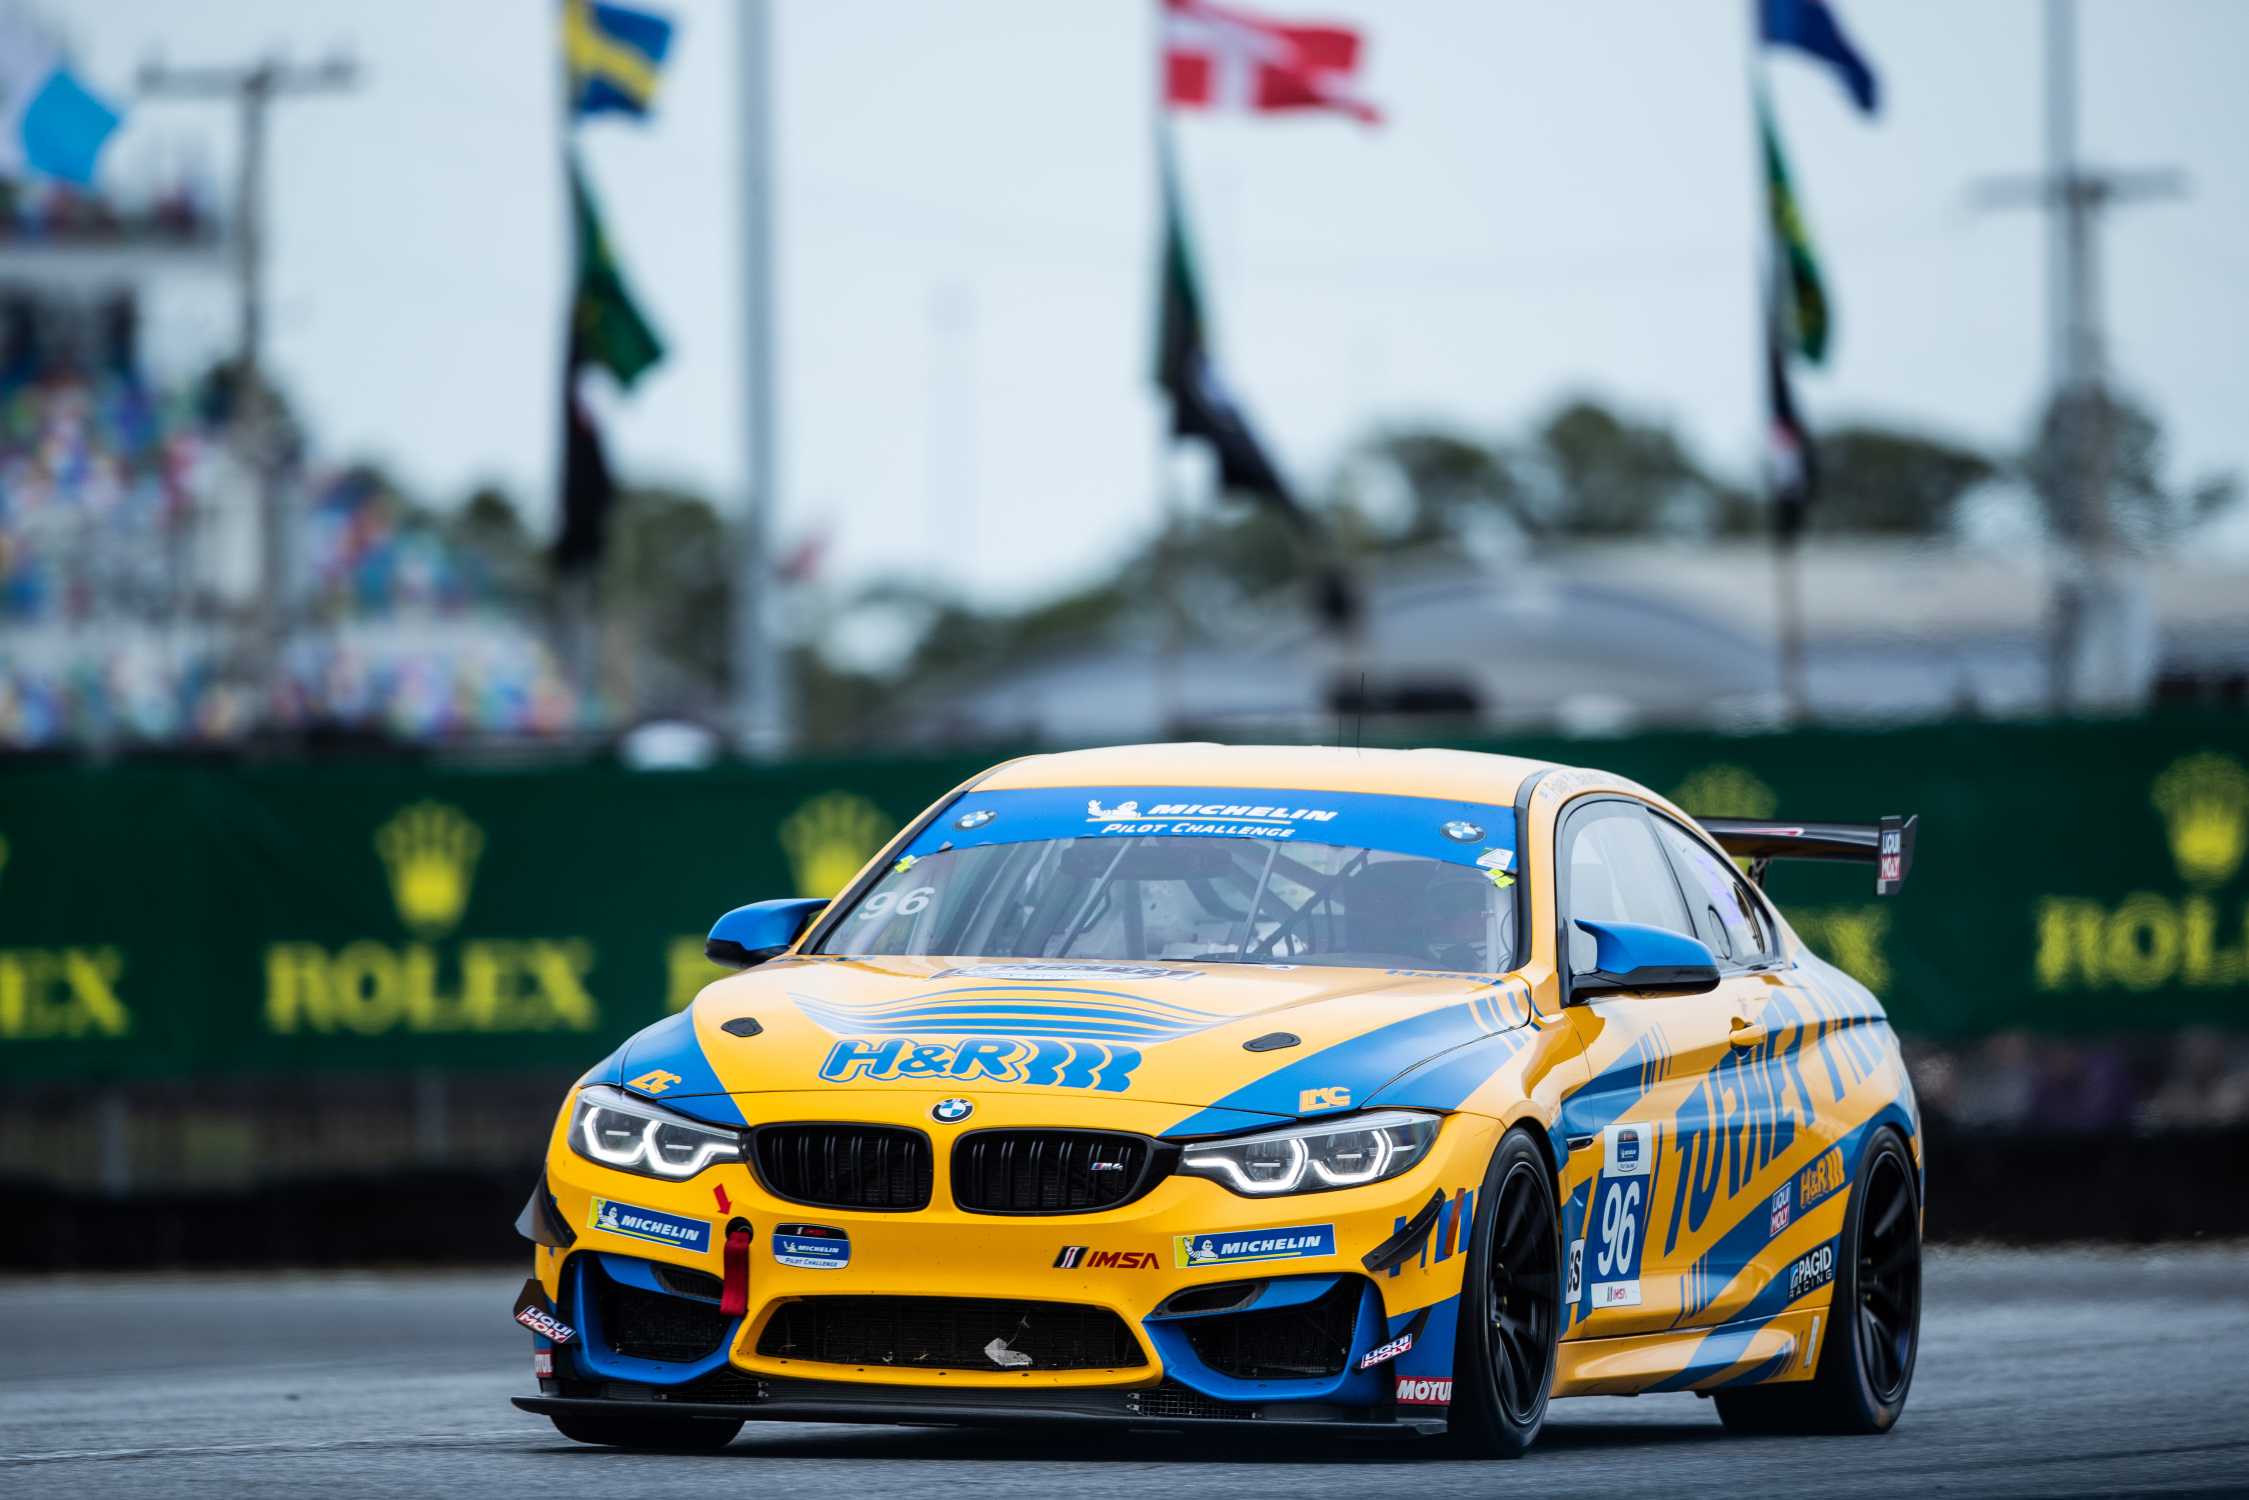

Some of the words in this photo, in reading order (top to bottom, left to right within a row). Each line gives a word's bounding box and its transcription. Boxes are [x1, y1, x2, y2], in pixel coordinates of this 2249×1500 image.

[1147, 804, 1339, 822] MICHELIN
[1101, 823, 1168, 834] PILOT
[1170, 822, 1296, 838] CHALLENGE
[859, 886, 936, 920] 96
[264, 938, 598, 1034] ROLEX
[818, 1038, 1040, 1083] H&R
[621, 1215, 699, 1241] MICHELIN
[1598, 1181, 1640, 1276] 96
[1770, 1204, 1791, 1234] MOLY
[797, 1245, 840, 1254] MICHELIN
[1221, 1235, 1321, 1255] MICHELIN
[1086, 1251, 1160, 1269] IMSA
[1798, 1246, 1832, 1283] PAGID
[519, 1313, 567, 1341] MOLY
[526, 1307, 574, 1336] LIQUI
[1364, 1342, 1411, 1367] MOLY
[1365, 1335, 1410, 1360] LIQUI
[1396, 1380, 1453, 1401] MOTU
